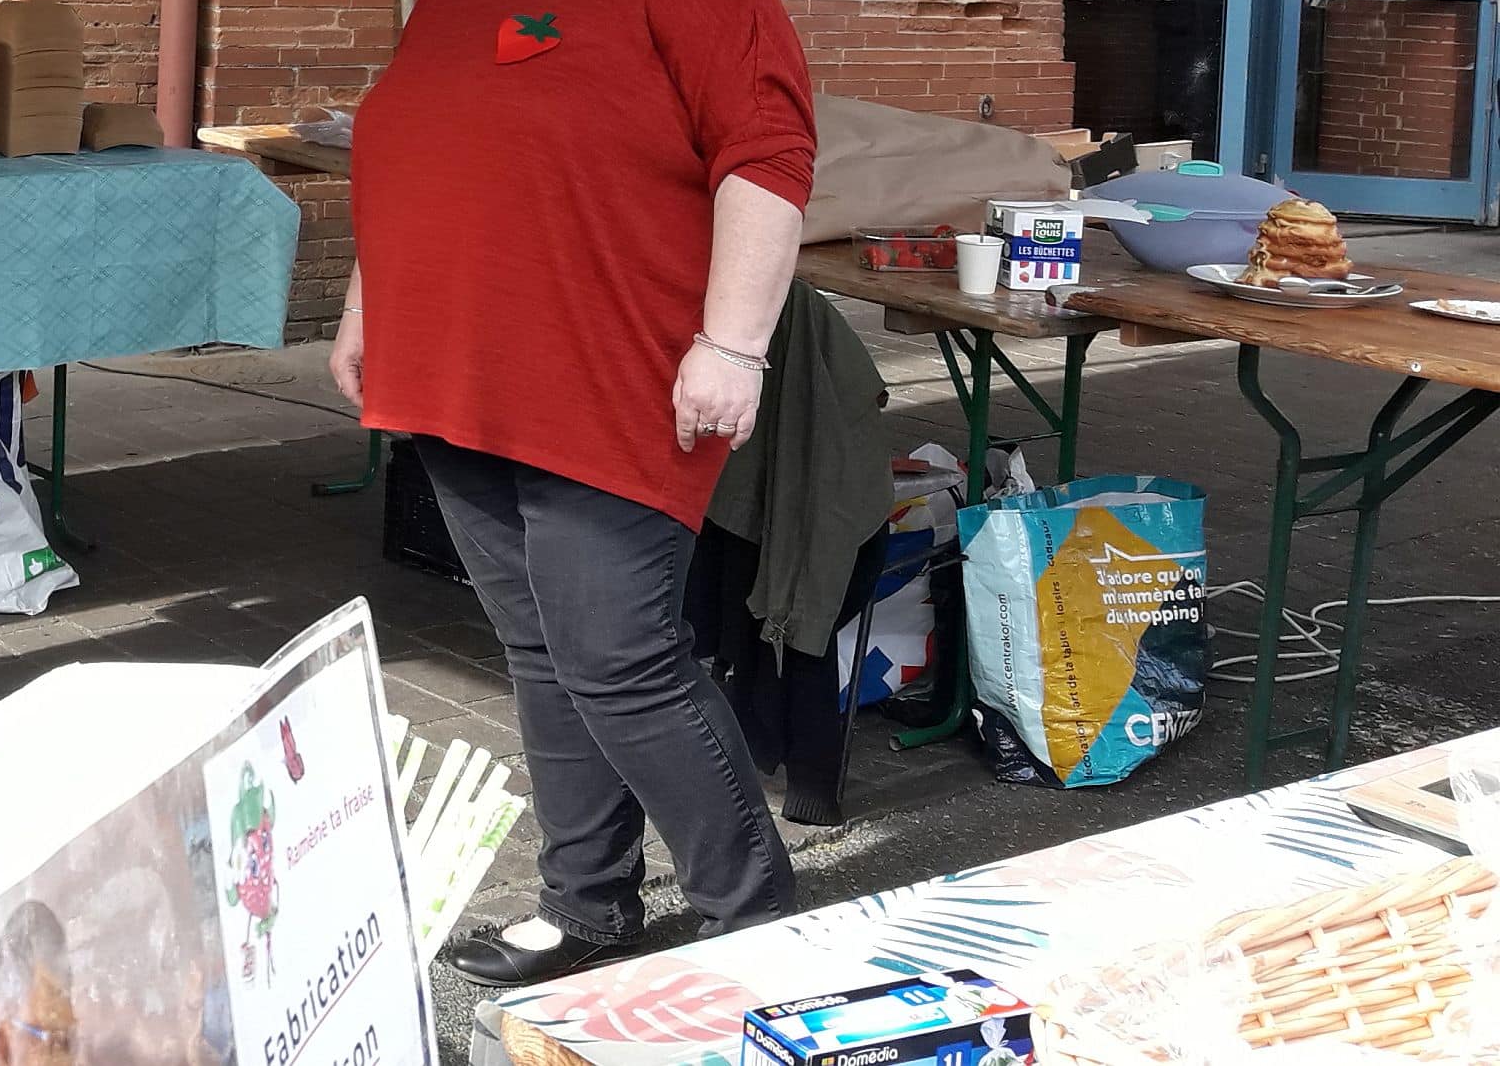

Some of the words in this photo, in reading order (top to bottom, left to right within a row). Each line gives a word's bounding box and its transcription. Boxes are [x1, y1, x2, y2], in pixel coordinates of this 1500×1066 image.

[1035, 220, 1062, 230] SAINT
[1035, 229, 1062, 238] LOUIS
[1018, 245, 1032, 255] LES
[1156, 565, 1203, 587] qu'on
[1051, 580, 1066, 617] loisirs
[998, 593, 1018, 712] www.centrakor.com
[1058, 629, 1073, 659] table
[1064, 660, 1075, 673] la
[1066, 673, 1078, 689] de
[1069, 690, 1082, 709] art
[286, 819, 328, 871] Ramène
[329, 809, 342, 831] ta
[343, 784, 375, 821] fraise
[263, 911, 381, 1066] Fabrication
